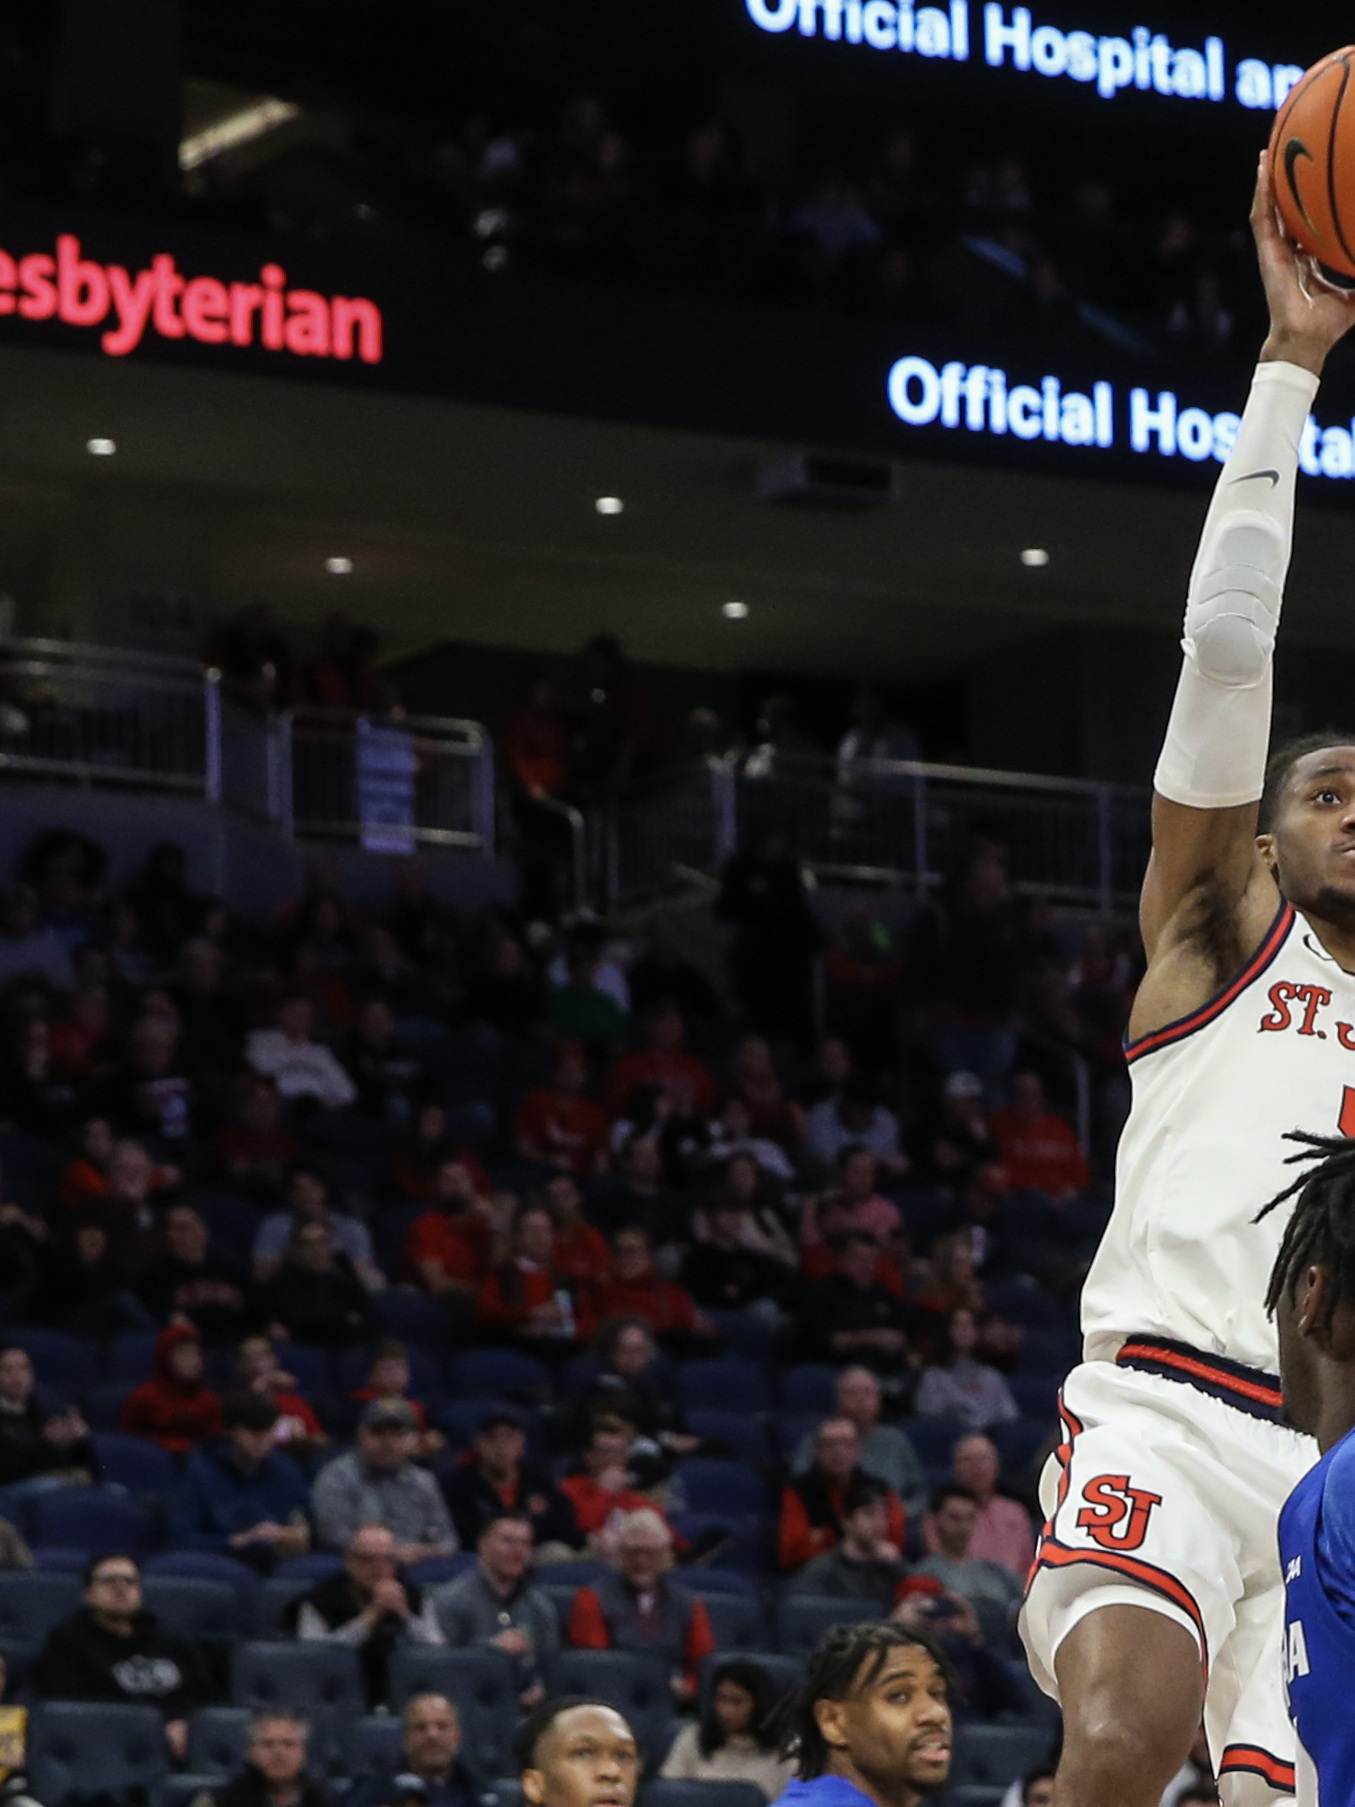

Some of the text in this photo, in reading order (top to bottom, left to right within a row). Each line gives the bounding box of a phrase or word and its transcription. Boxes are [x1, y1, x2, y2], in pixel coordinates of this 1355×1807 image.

[983, 2, 1225, 99] Hospital
[1235, 57, 1306, 110] an
[886, 355, 1113, 449] Official
[1257, 980, 1333, 1040] ST.
